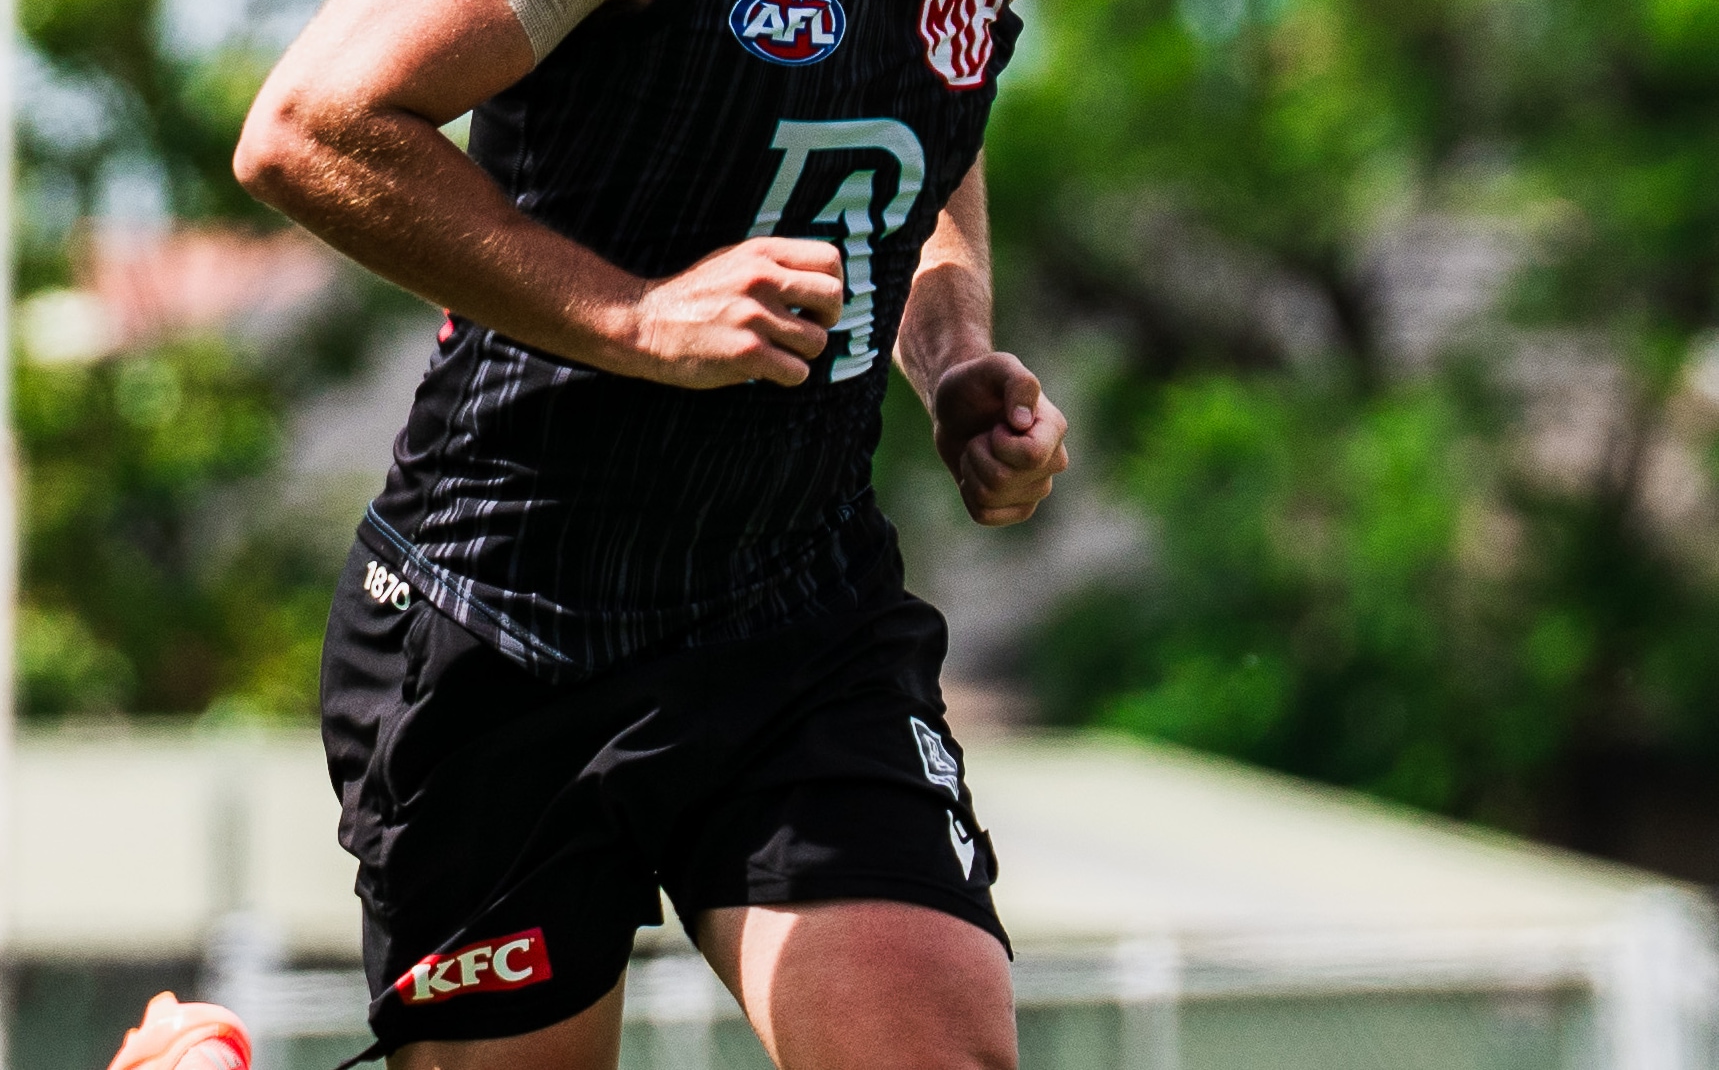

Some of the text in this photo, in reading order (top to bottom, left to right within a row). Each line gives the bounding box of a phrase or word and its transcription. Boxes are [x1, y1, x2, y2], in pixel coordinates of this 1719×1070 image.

[742, 2, 835, 45] AFL
[363, 559, 411, 611] 1870
[412, 938, 534, 1000] KFC
